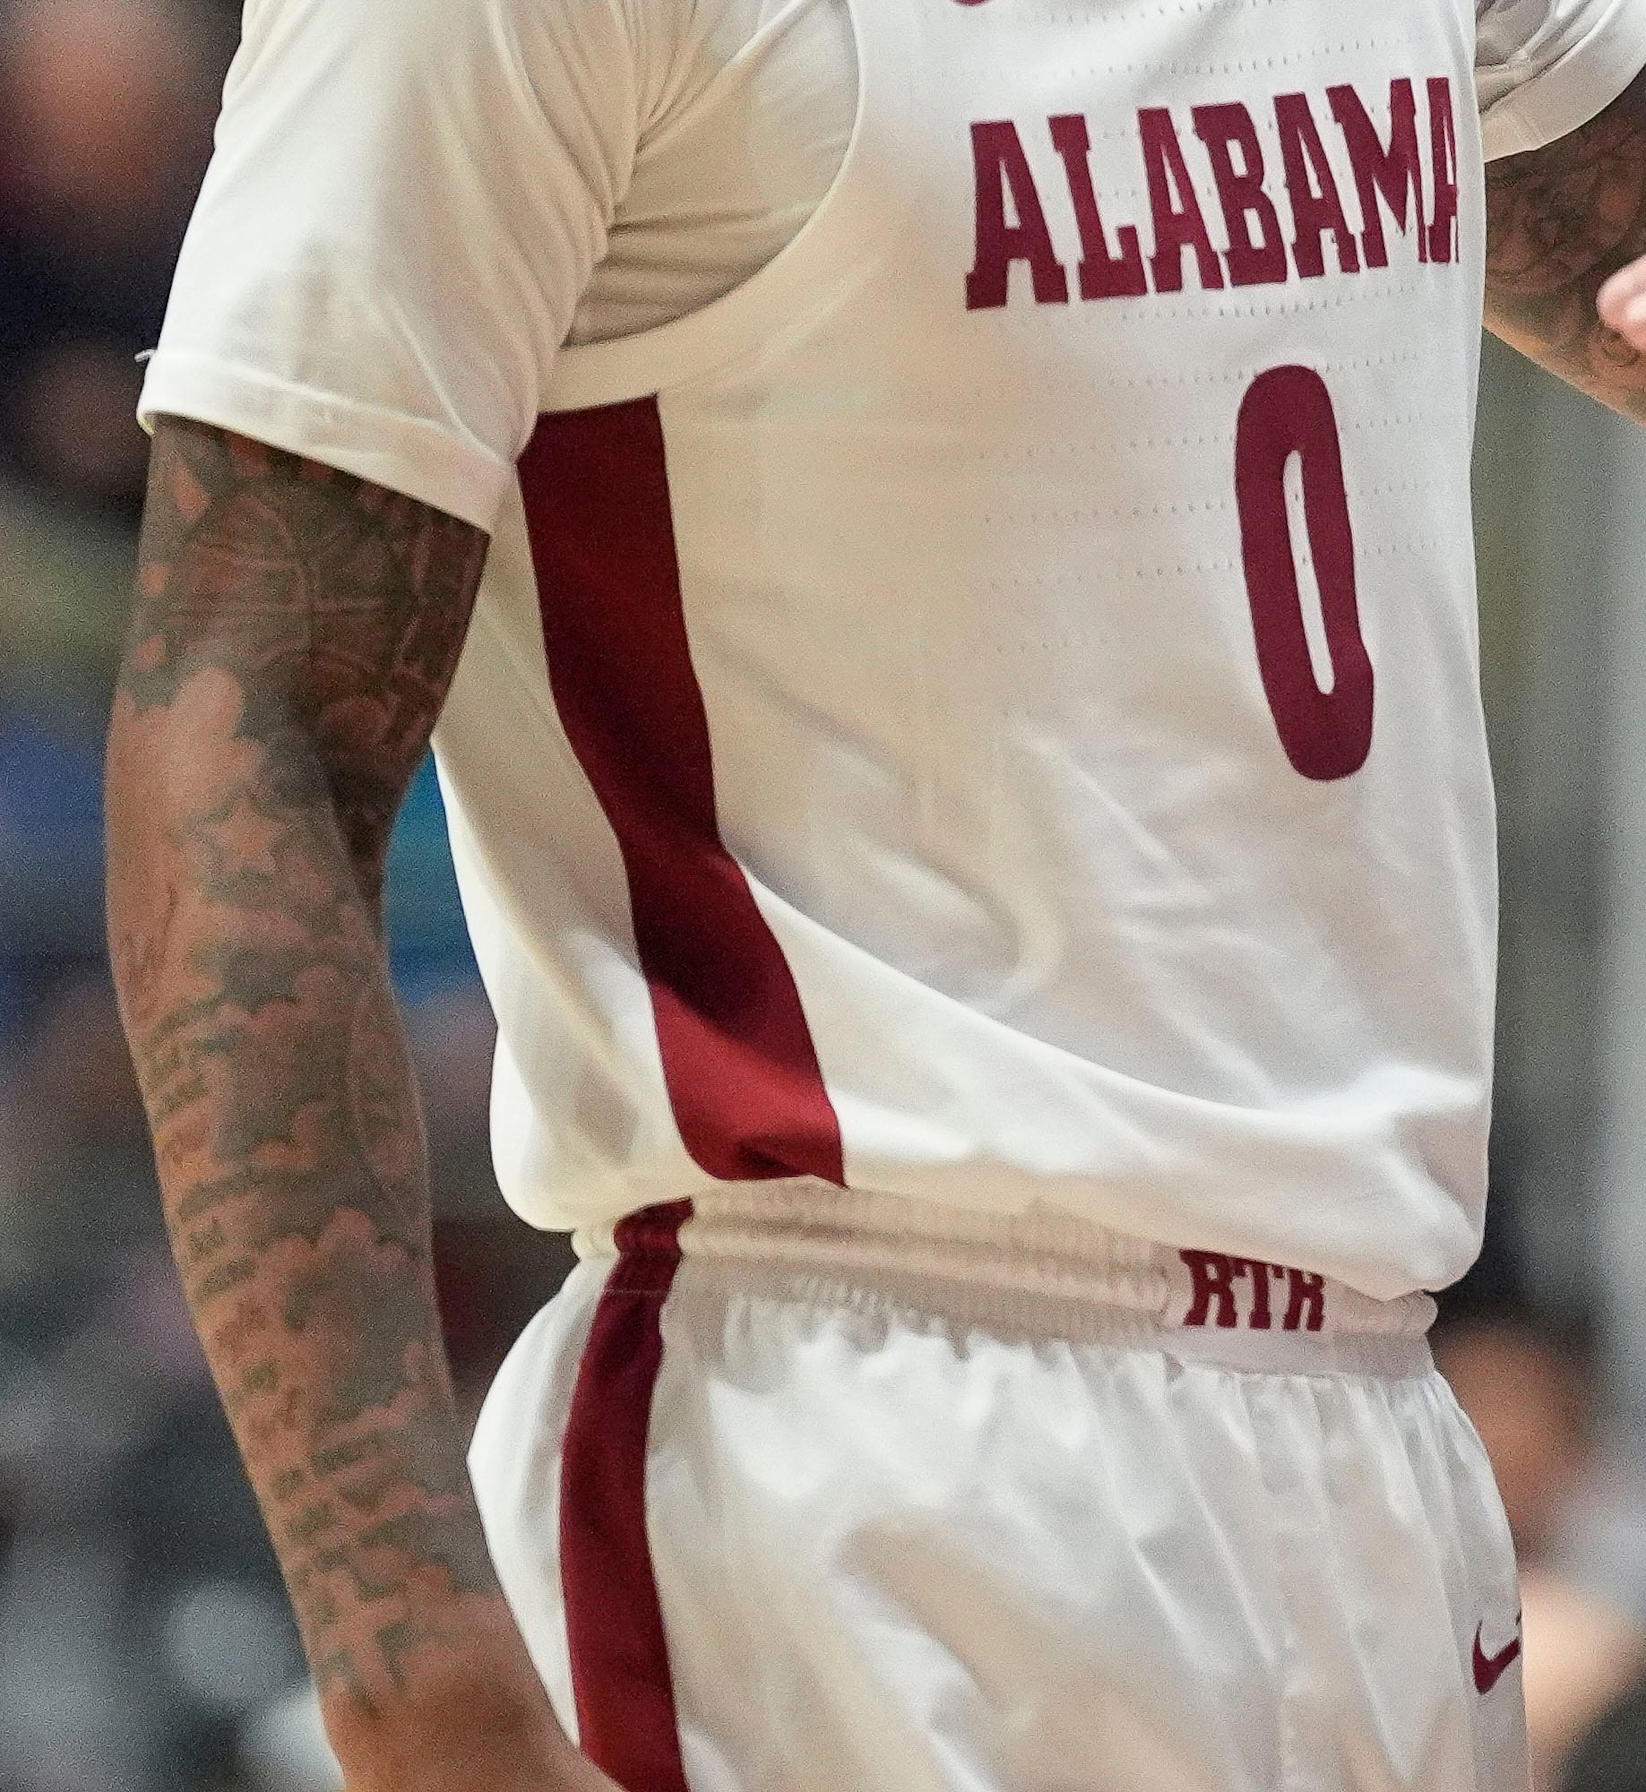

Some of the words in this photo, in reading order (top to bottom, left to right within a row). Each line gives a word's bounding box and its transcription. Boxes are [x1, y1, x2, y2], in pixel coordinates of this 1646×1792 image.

[966, 77, 1459, 310] ALABAMA
[1235, 364, 1374, 781] 0
[1178, 1249, 1325, 1332] RTR
